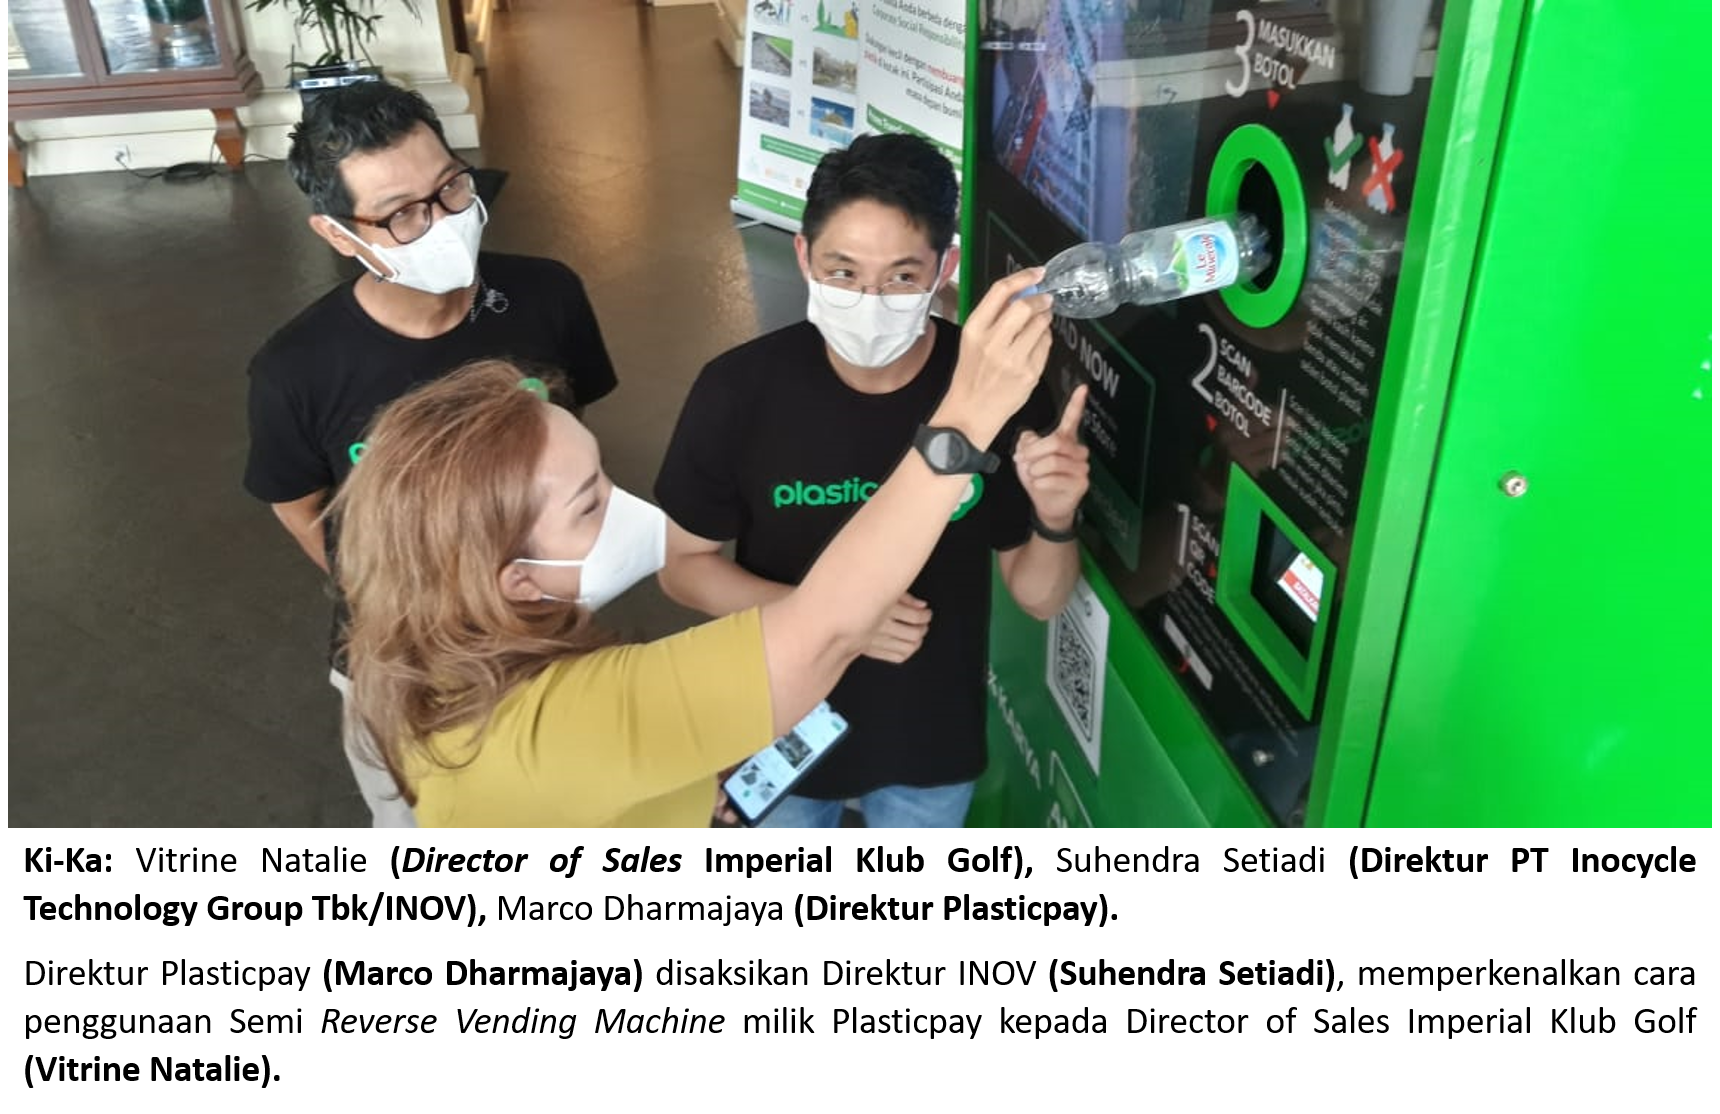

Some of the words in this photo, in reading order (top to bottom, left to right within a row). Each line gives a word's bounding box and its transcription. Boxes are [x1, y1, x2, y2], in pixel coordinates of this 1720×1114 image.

[1225, 9, 1256, 98] 3
[1258, 18, 1336, 70] MASUKKAN
[1253, 52, 1297, 90] BOTOL
[1079, 336, 1120, 400] NOW
[1191, 323, 1219, 404] 2
[1219, 337, 1252, 378] SCAN
[1214, 390, 1251, 439] BOTOL
[1217, 364, 1272, 427] BARCODE
[1178, 503, 1190, 568] 1
[1189, 539, 1205, 566] QR
[1192, 515, 1220, 557] SCAN
[1186, 561, 1215, 605] CODE
